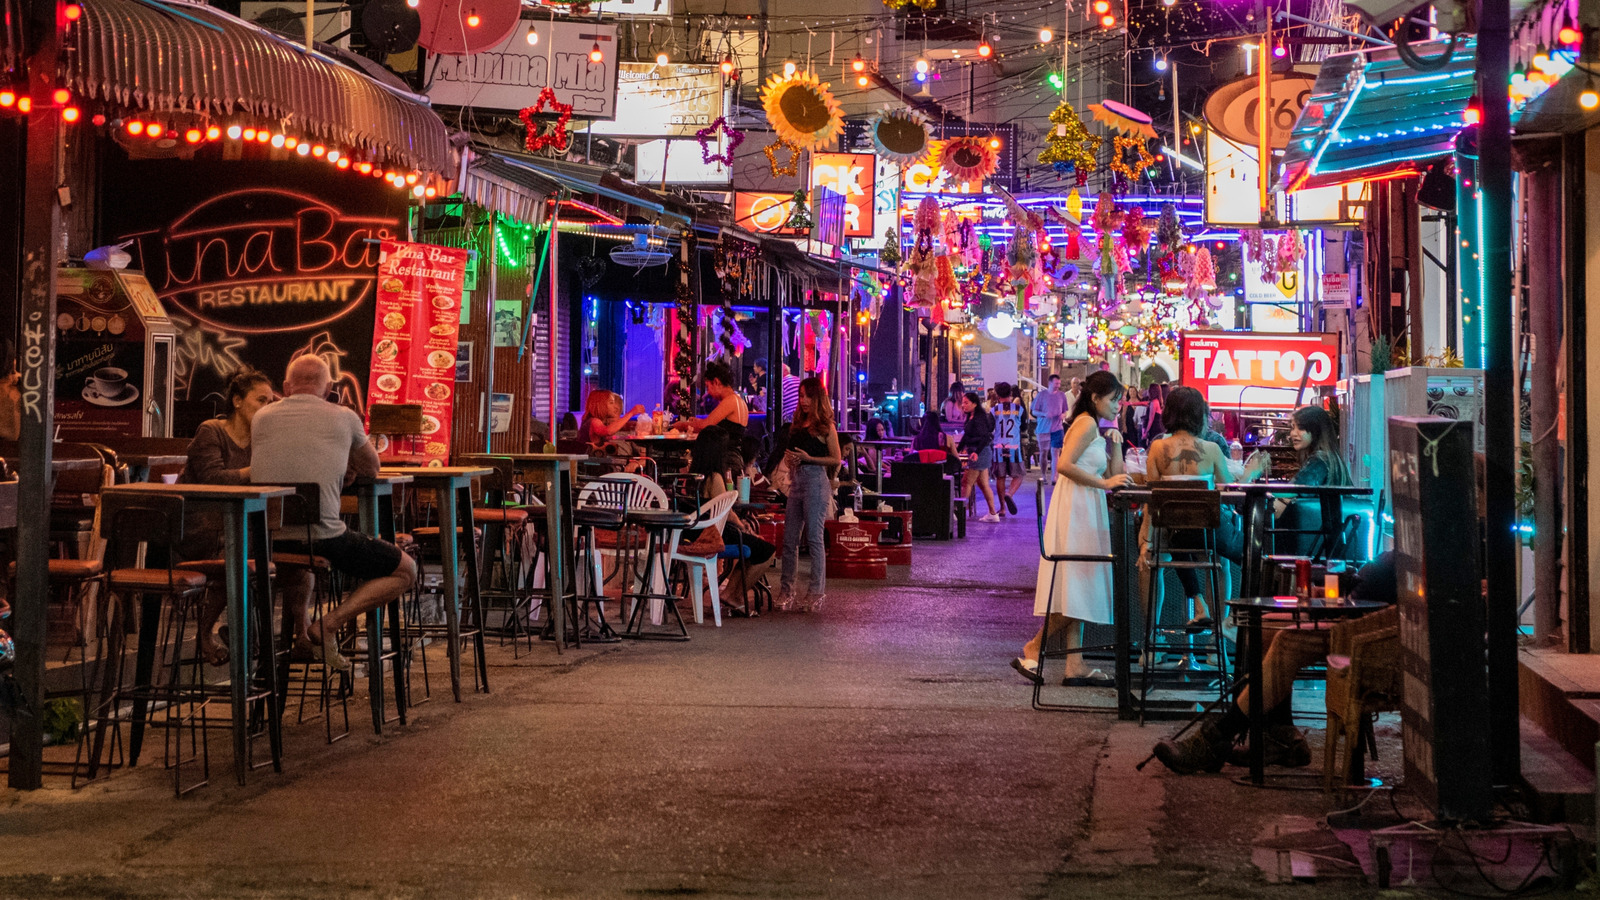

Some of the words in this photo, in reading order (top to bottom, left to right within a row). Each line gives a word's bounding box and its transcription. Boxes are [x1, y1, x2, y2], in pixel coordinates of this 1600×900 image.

[619, 69, 650, 80] Welcome
[671, 114, 709, 125] BAR
[429, 247, 455, 264] Bar
[388, 259, 456, 281] Restaurant
[199, 279, 354, 309] RESTAURANT
[1189, 350, 1332, 382] TATTOO
[999, 418, 1015, 438] 12
